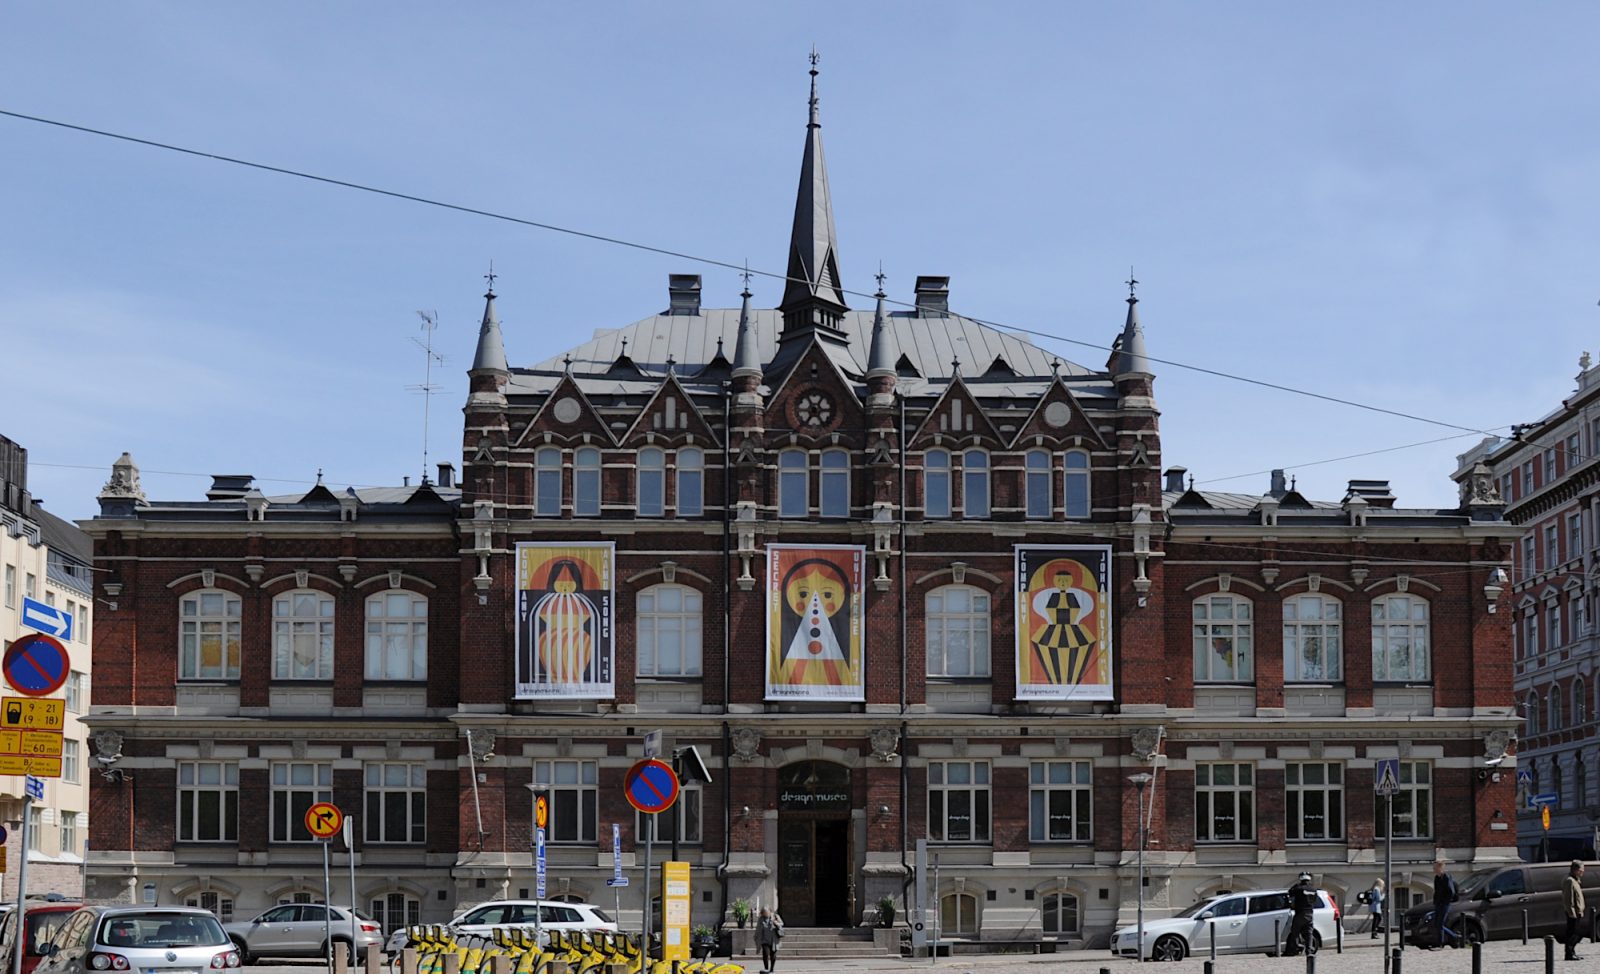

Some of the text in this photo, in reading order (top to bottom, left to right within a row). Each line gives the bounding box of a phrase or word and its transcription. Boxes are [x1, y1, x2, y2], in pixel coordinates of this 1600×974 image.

[29, 703, 35, 713] 9
[46, 704, 56, 713] 21
[23, 714, 34, 724] (9
[45, 716, 59, 725] 18)
[33, 743, 45, 753] 60
[46, 746, 60, 754] min
